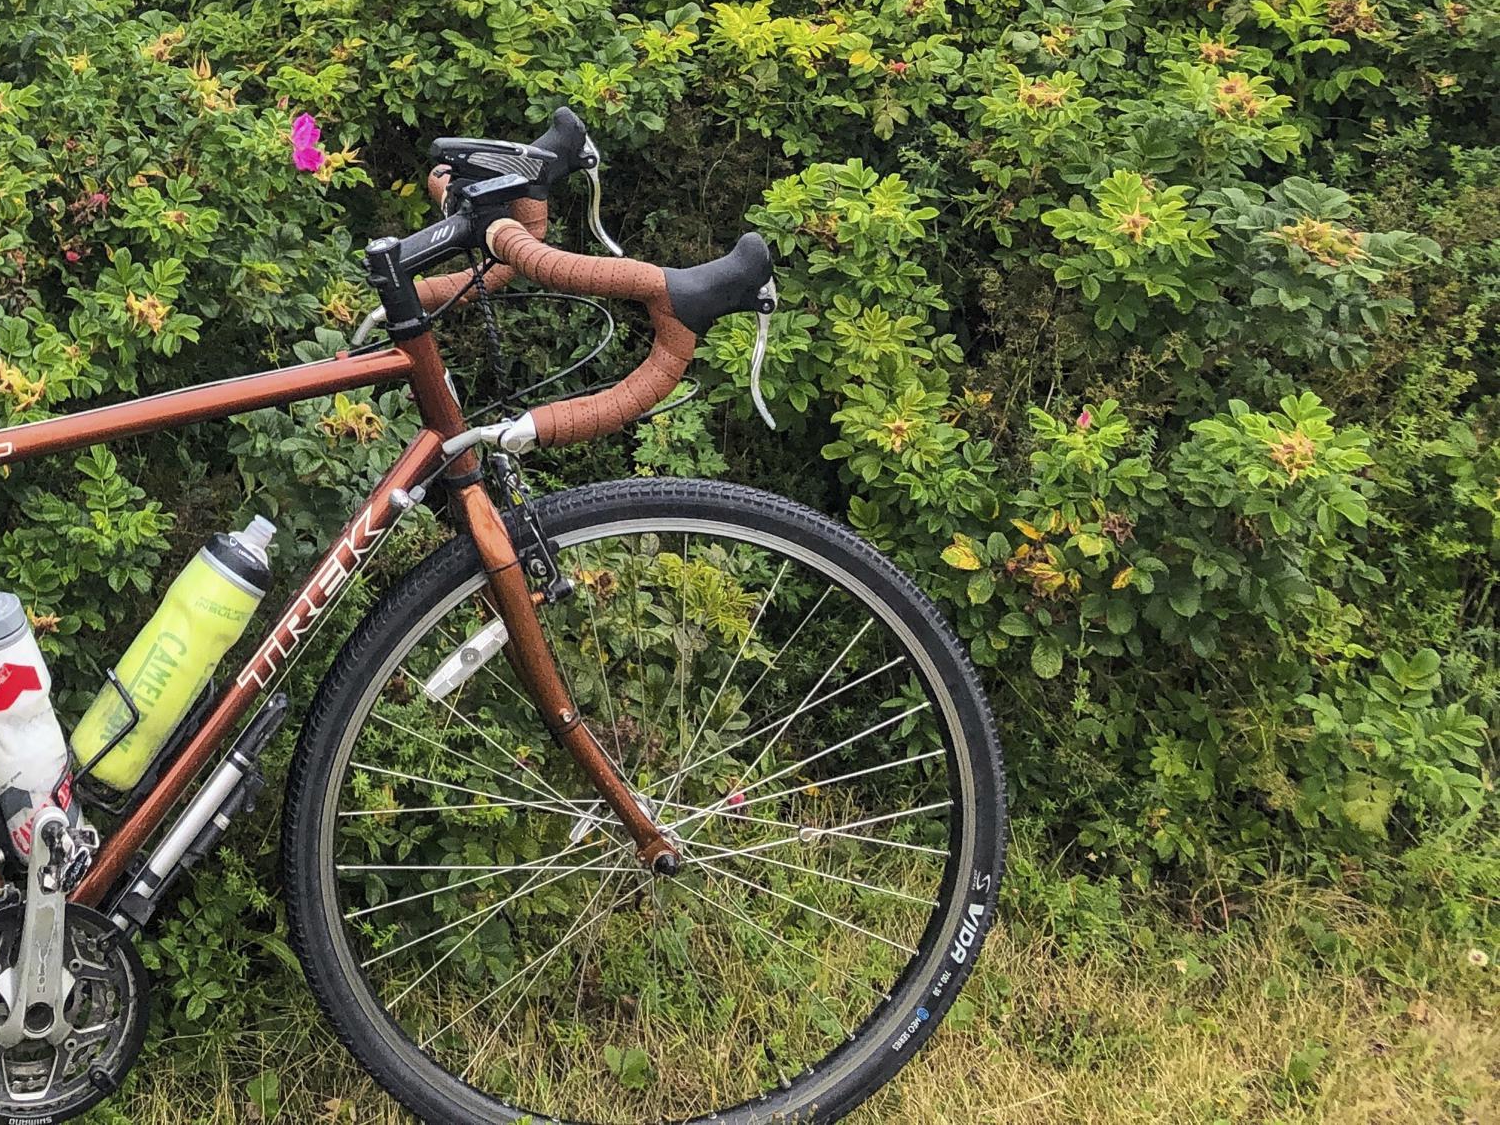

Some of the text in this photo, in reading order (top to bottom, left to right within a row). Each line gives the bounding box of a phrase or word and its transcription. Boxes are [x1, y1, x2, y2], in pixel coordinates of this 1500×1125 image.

[236, 504, 386, 689] TREK
[950, 903, 985, 965] VIDA
[941, 970, 952, 984] 700
[891, 1030, 912, 1052] SERIES
